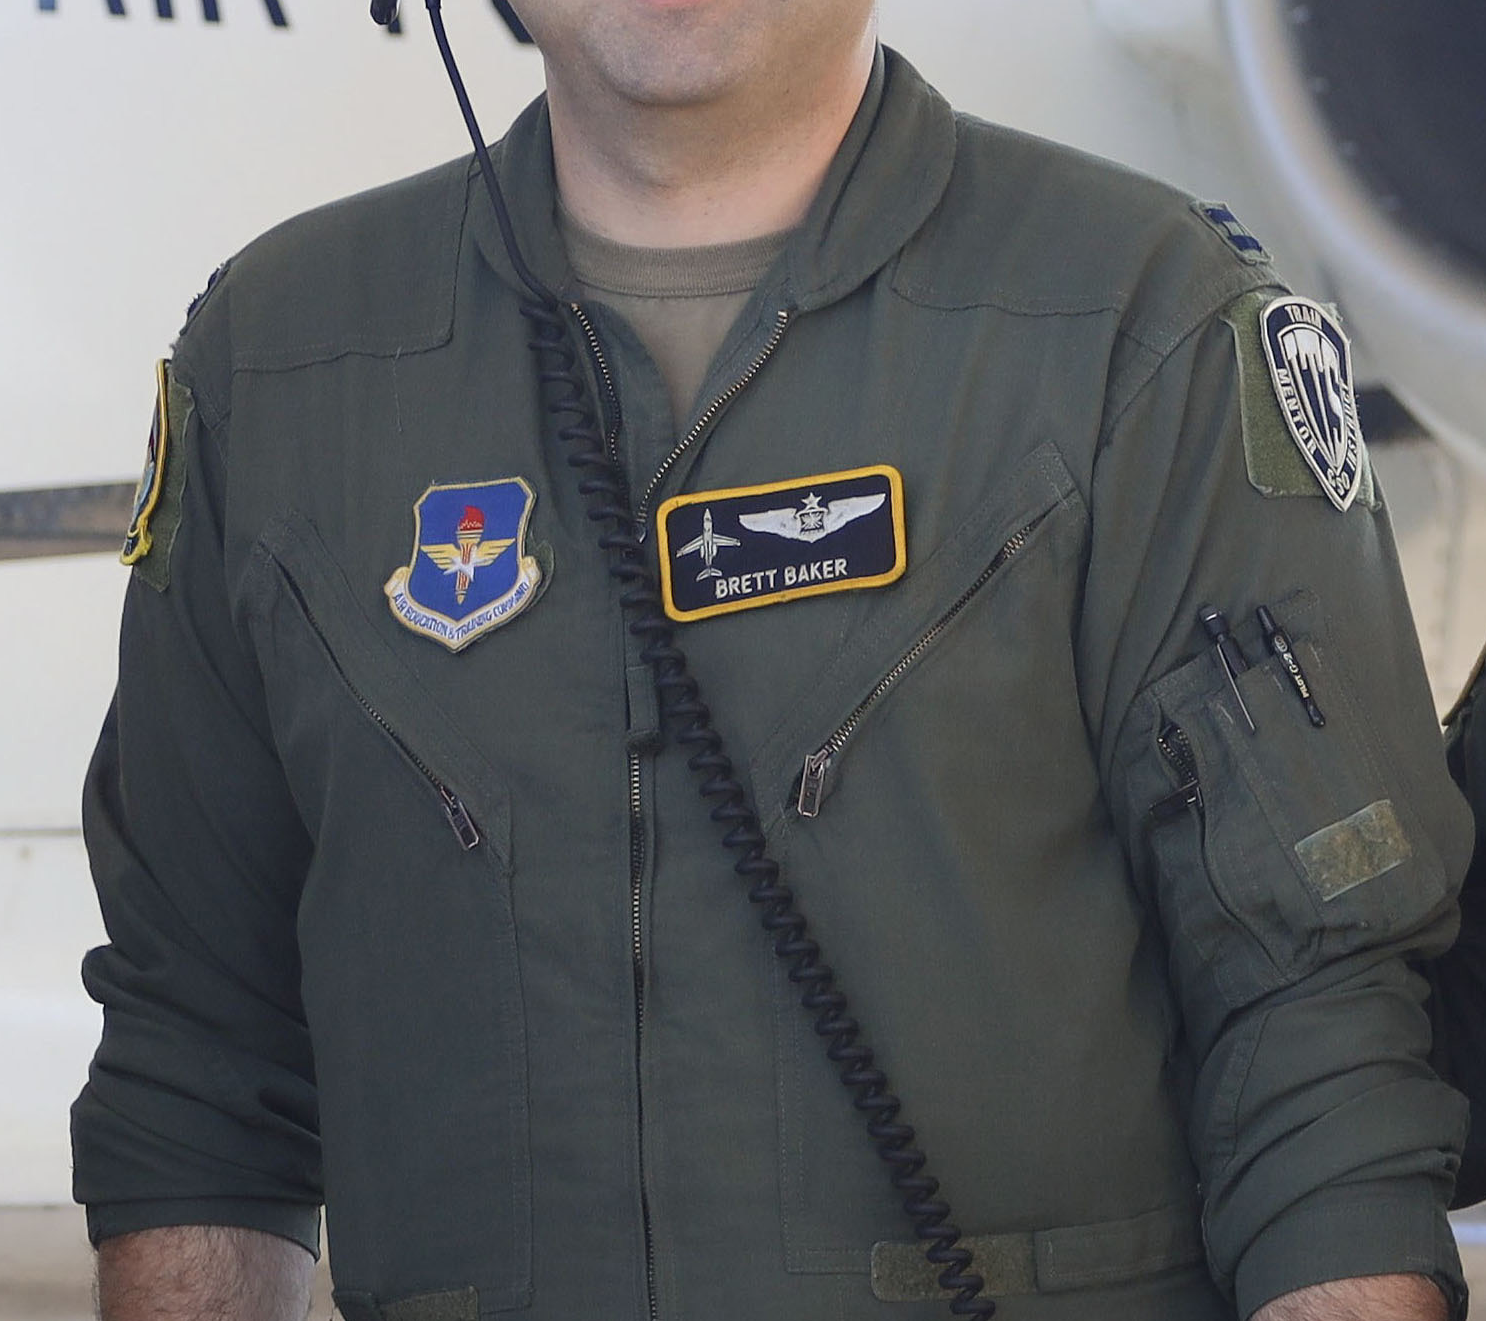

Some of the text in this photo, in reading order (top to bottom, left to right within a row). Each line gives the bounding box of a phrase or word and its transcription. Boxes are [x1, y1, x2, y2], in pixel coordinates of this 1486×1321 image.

[1277, 368, 1317, 455] MENTOR
[715, 558, 848, 599] BRETT BAKER
[393, 592, 407, 614] AIR
[1283, 652, 1299, 674] G-2
[1295, 675, 1310, 698] PILOT
